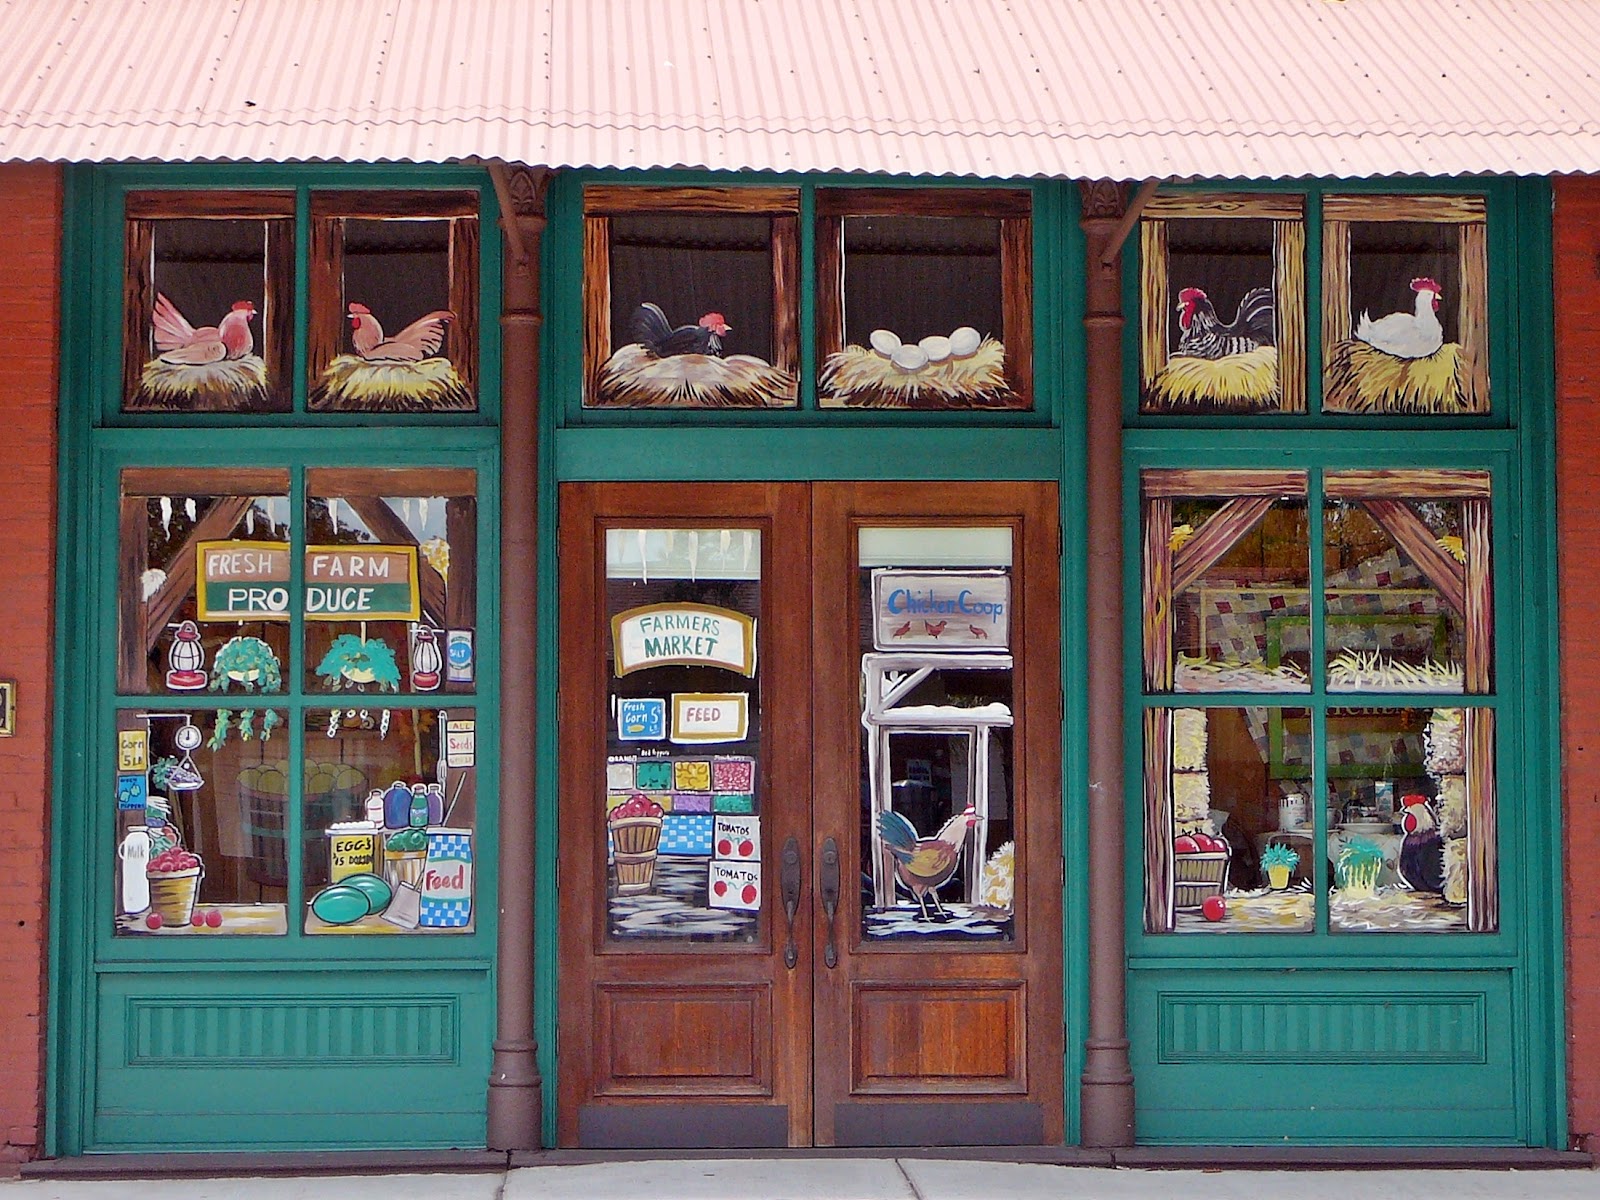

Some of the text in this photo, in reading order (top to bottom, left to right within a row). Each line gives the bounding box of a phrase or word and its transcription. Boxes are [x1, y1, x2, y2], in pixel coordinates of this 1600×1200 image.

[207, 553, 389, 578] FRESH FARM
[887, 588, 1003, 624] Chicken Coop
[639, 614, 721, 636] FARMERS
[644, 635, 719, 658] MARKET
[623, 702, 645, 711] Fresh
[625, 712, 648, 723] Corn
[686, 707, 721, 722] FEED
[121, 739, 145, 749] Corn
[717, 822, 750, 836] TOMATOS
[127, 844, 145, 859] Milk
[425, 864, 464, 891] Feed
[714, 867, 759, 881] TOMATOS
